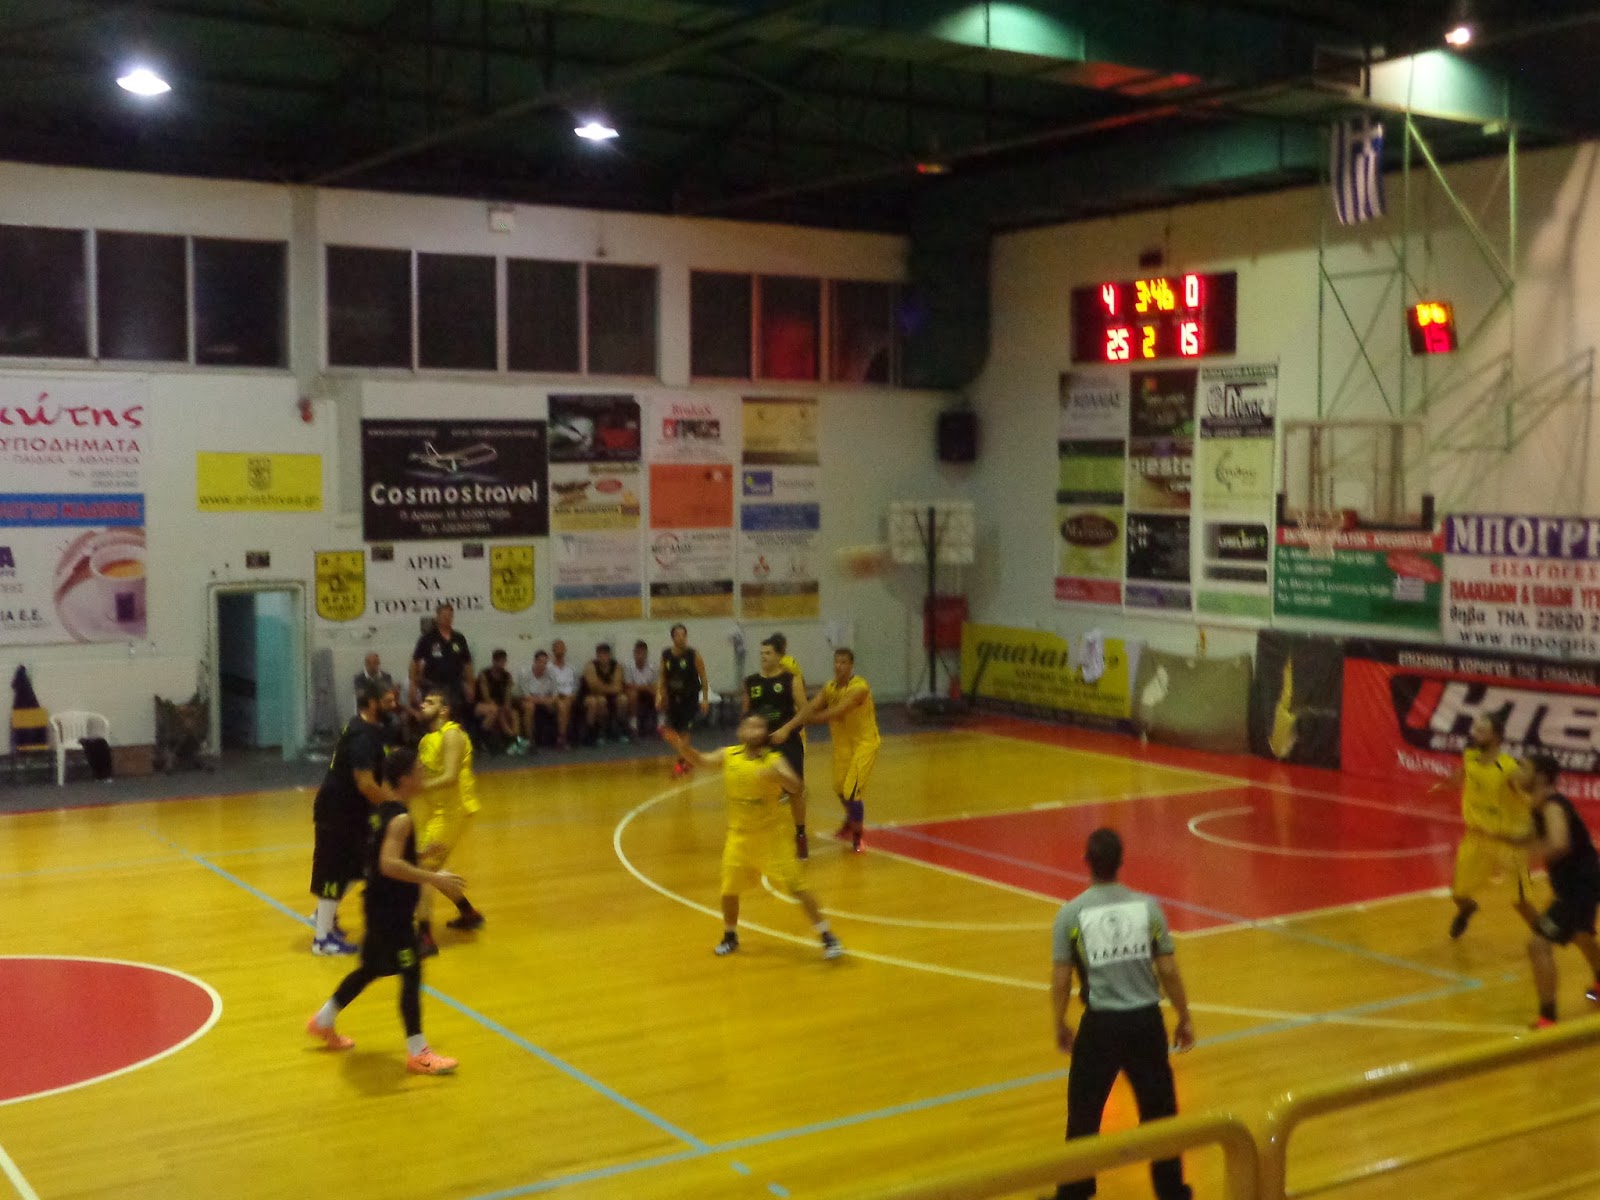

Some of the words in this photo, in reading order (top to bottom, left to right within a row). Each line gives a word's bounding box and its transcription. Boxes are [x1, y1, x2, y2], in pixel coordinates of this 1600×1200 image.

[1103, 284, 1115, 315] 4
[1185, 274, 1199, 308] 0
[1107, 328, 1129, 361] 25
[1142, 325, 1156, 359] 2
[1181, 321, 1199, 356] 15
[370, 480, 539, 506] Cosmostravel
[406, 554, 453, 570] ΑΡΗΣ
[417, 576, 440, 591] ΝΑ
